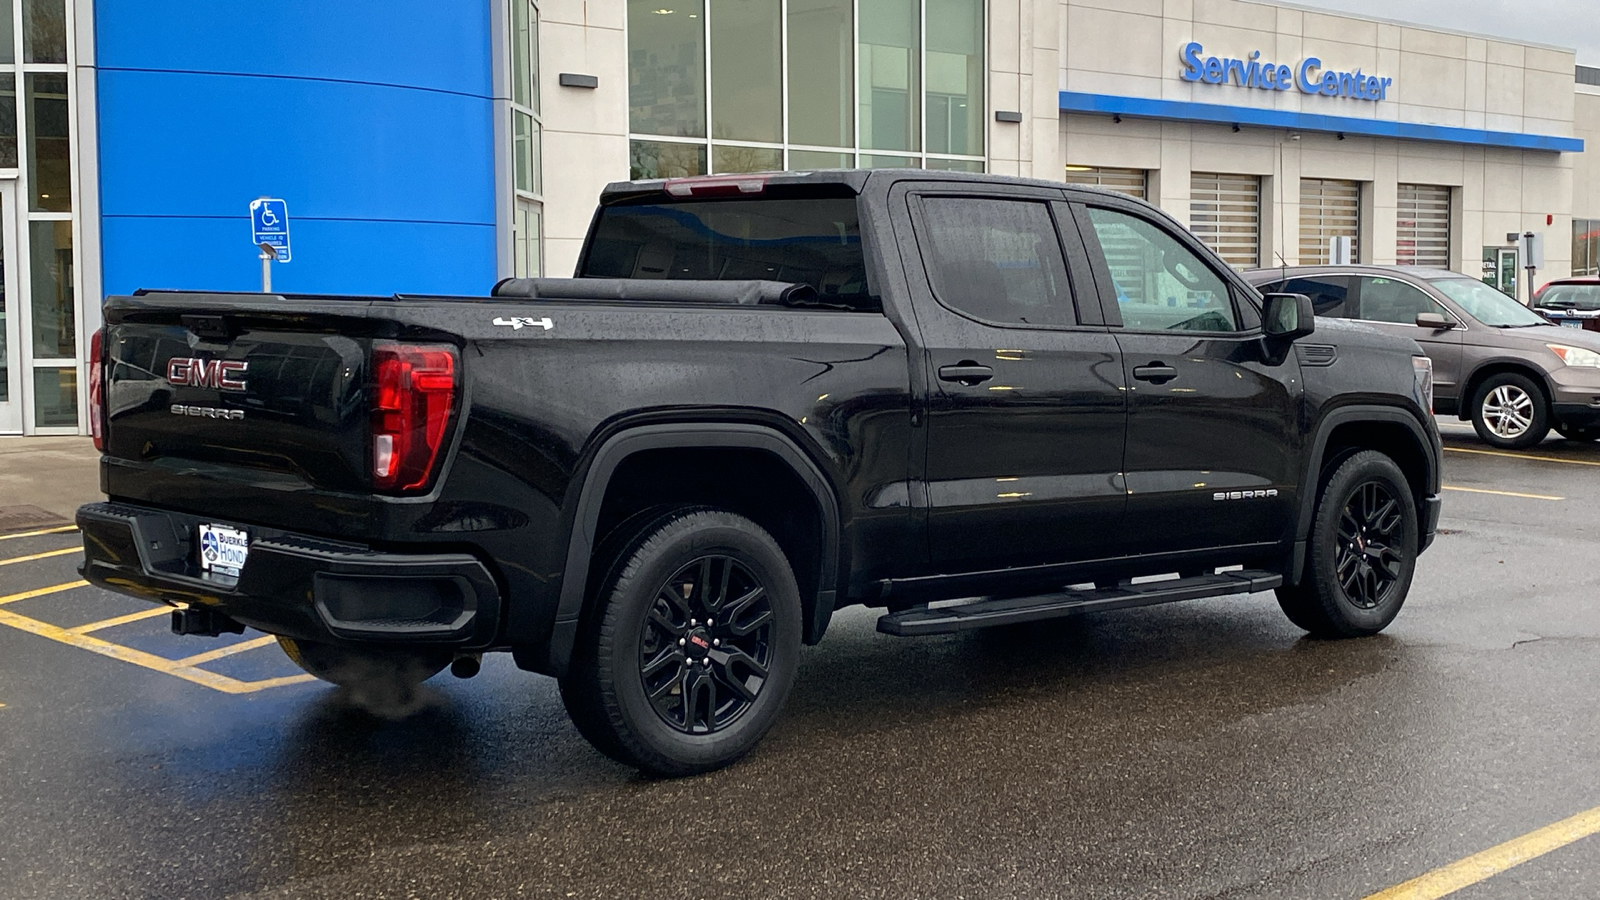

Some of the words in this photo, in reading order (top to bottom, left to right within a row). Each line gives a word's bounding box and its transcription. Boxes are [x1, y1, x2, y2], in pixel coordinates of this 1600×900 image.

[1181, 42, 1292, 92] Service
[1296, 57, 1392, 100] Center
[1482, 261, 1497, 269] ETAIL
[167, 357, 248, 391] GMC
[170, 404, 245, 420] SIERRA
[1213, 489, 1278, 501] SIERRA
[219, 532, 248, 548] BUERKLE
